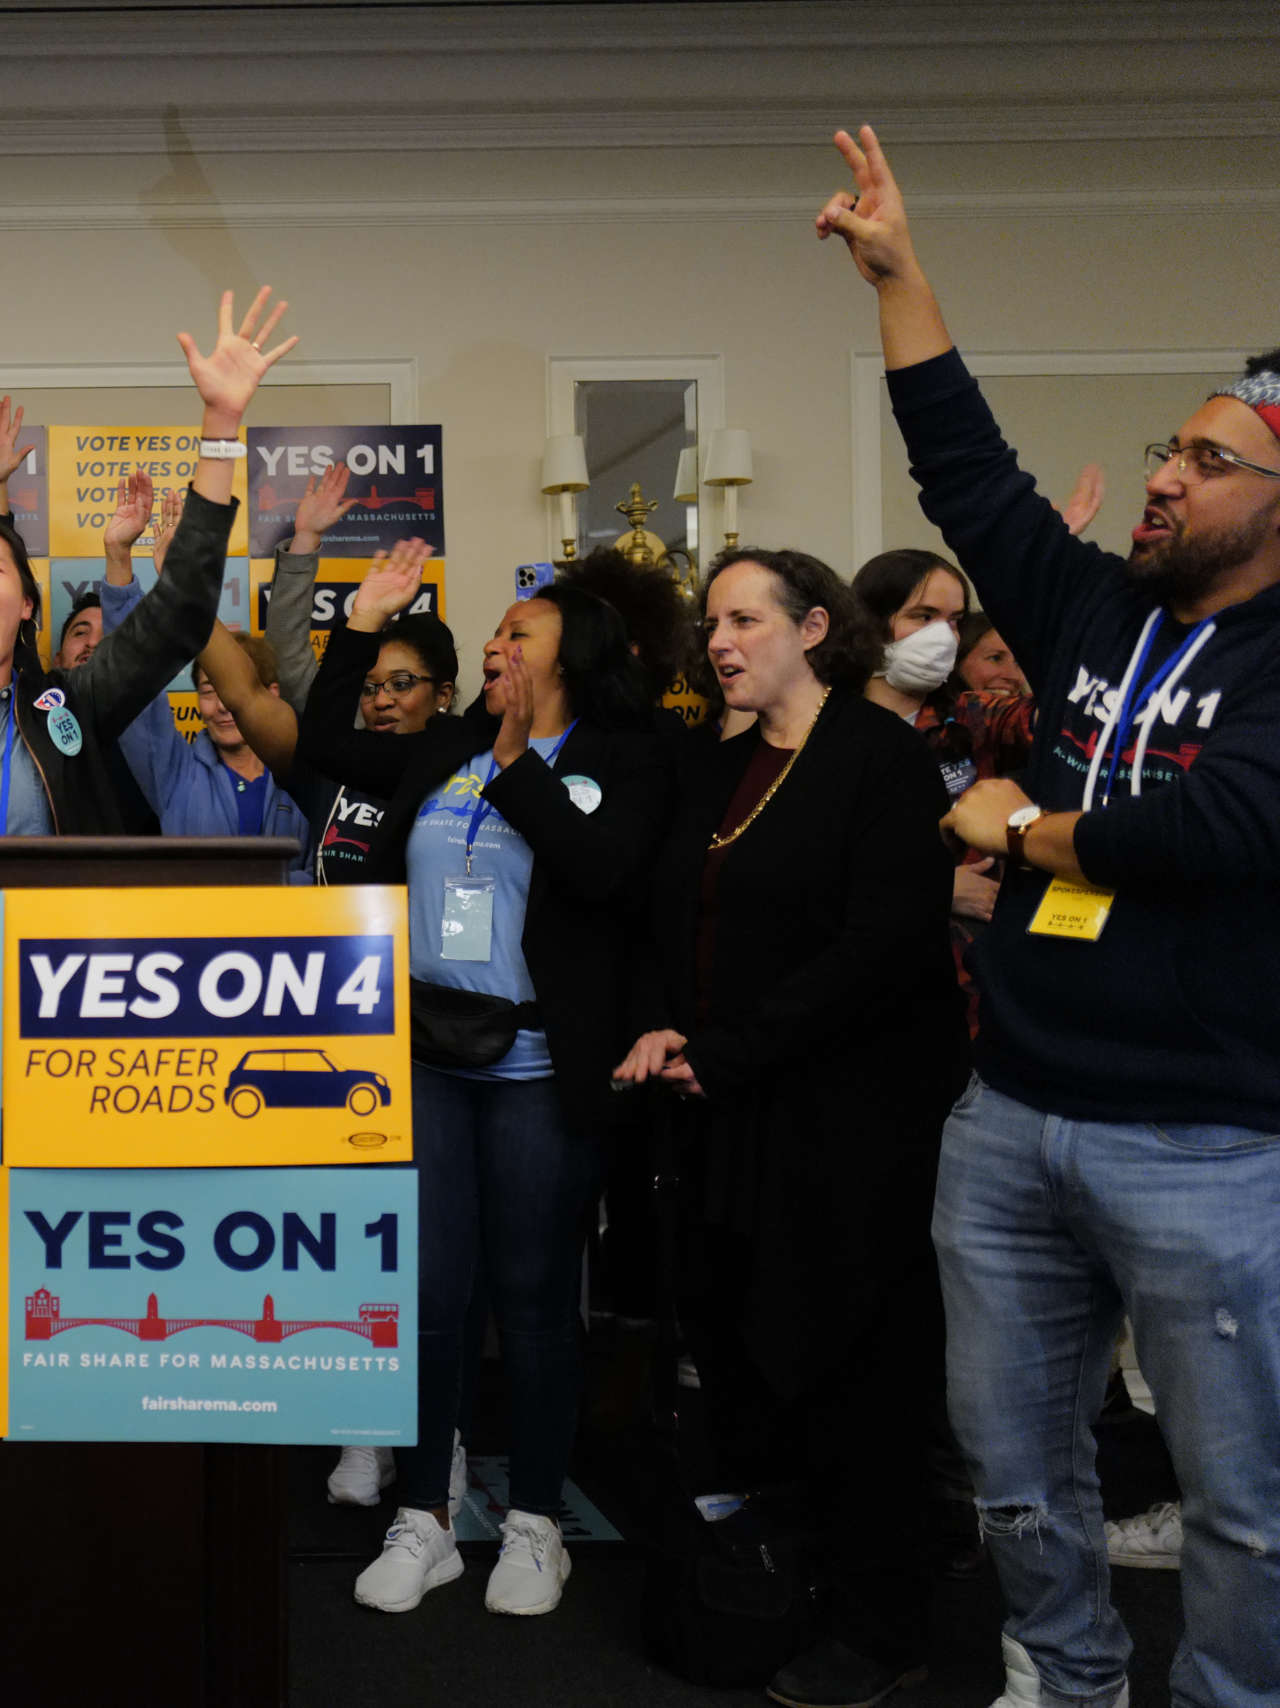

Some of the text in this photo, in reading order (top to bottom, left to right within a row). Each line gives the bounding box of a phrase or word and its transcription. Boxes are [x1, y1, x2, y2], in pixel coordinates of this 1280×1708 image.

[76, 436, 131, 451] VOTE
[135, 436, 171, 450] YES
[76, 462, 131, 477] VOTE
[135, 461, 170, 476] YES
[256, 444, 435, 476] YES ON 1
[76, 513, 113, 528] VO
[347, 513, 436, 522] MASSACHUSETTS
[224, 577, 241, 606] 1
[1067, 666, 1124, 724] YES
[1196, 692, 1221, 729] 1
[56, 718, 74, 734] YES
[61, 733, 74, 745] ON
[339, 851, 364, 863] SHAR
[29, 951, 381, 1019] YES ON 4
[25, 1049, 218, 1078] FOR SAFER
[90, 1084, 216, 1114] ROADS
[24, 1210, 398, 1272] YES ON 1
[23, 1353, 399, 1372] FAIR SHARE FOR MASSACHUSETTS
[142, 1396, 277, 1413] fairsharema.com
